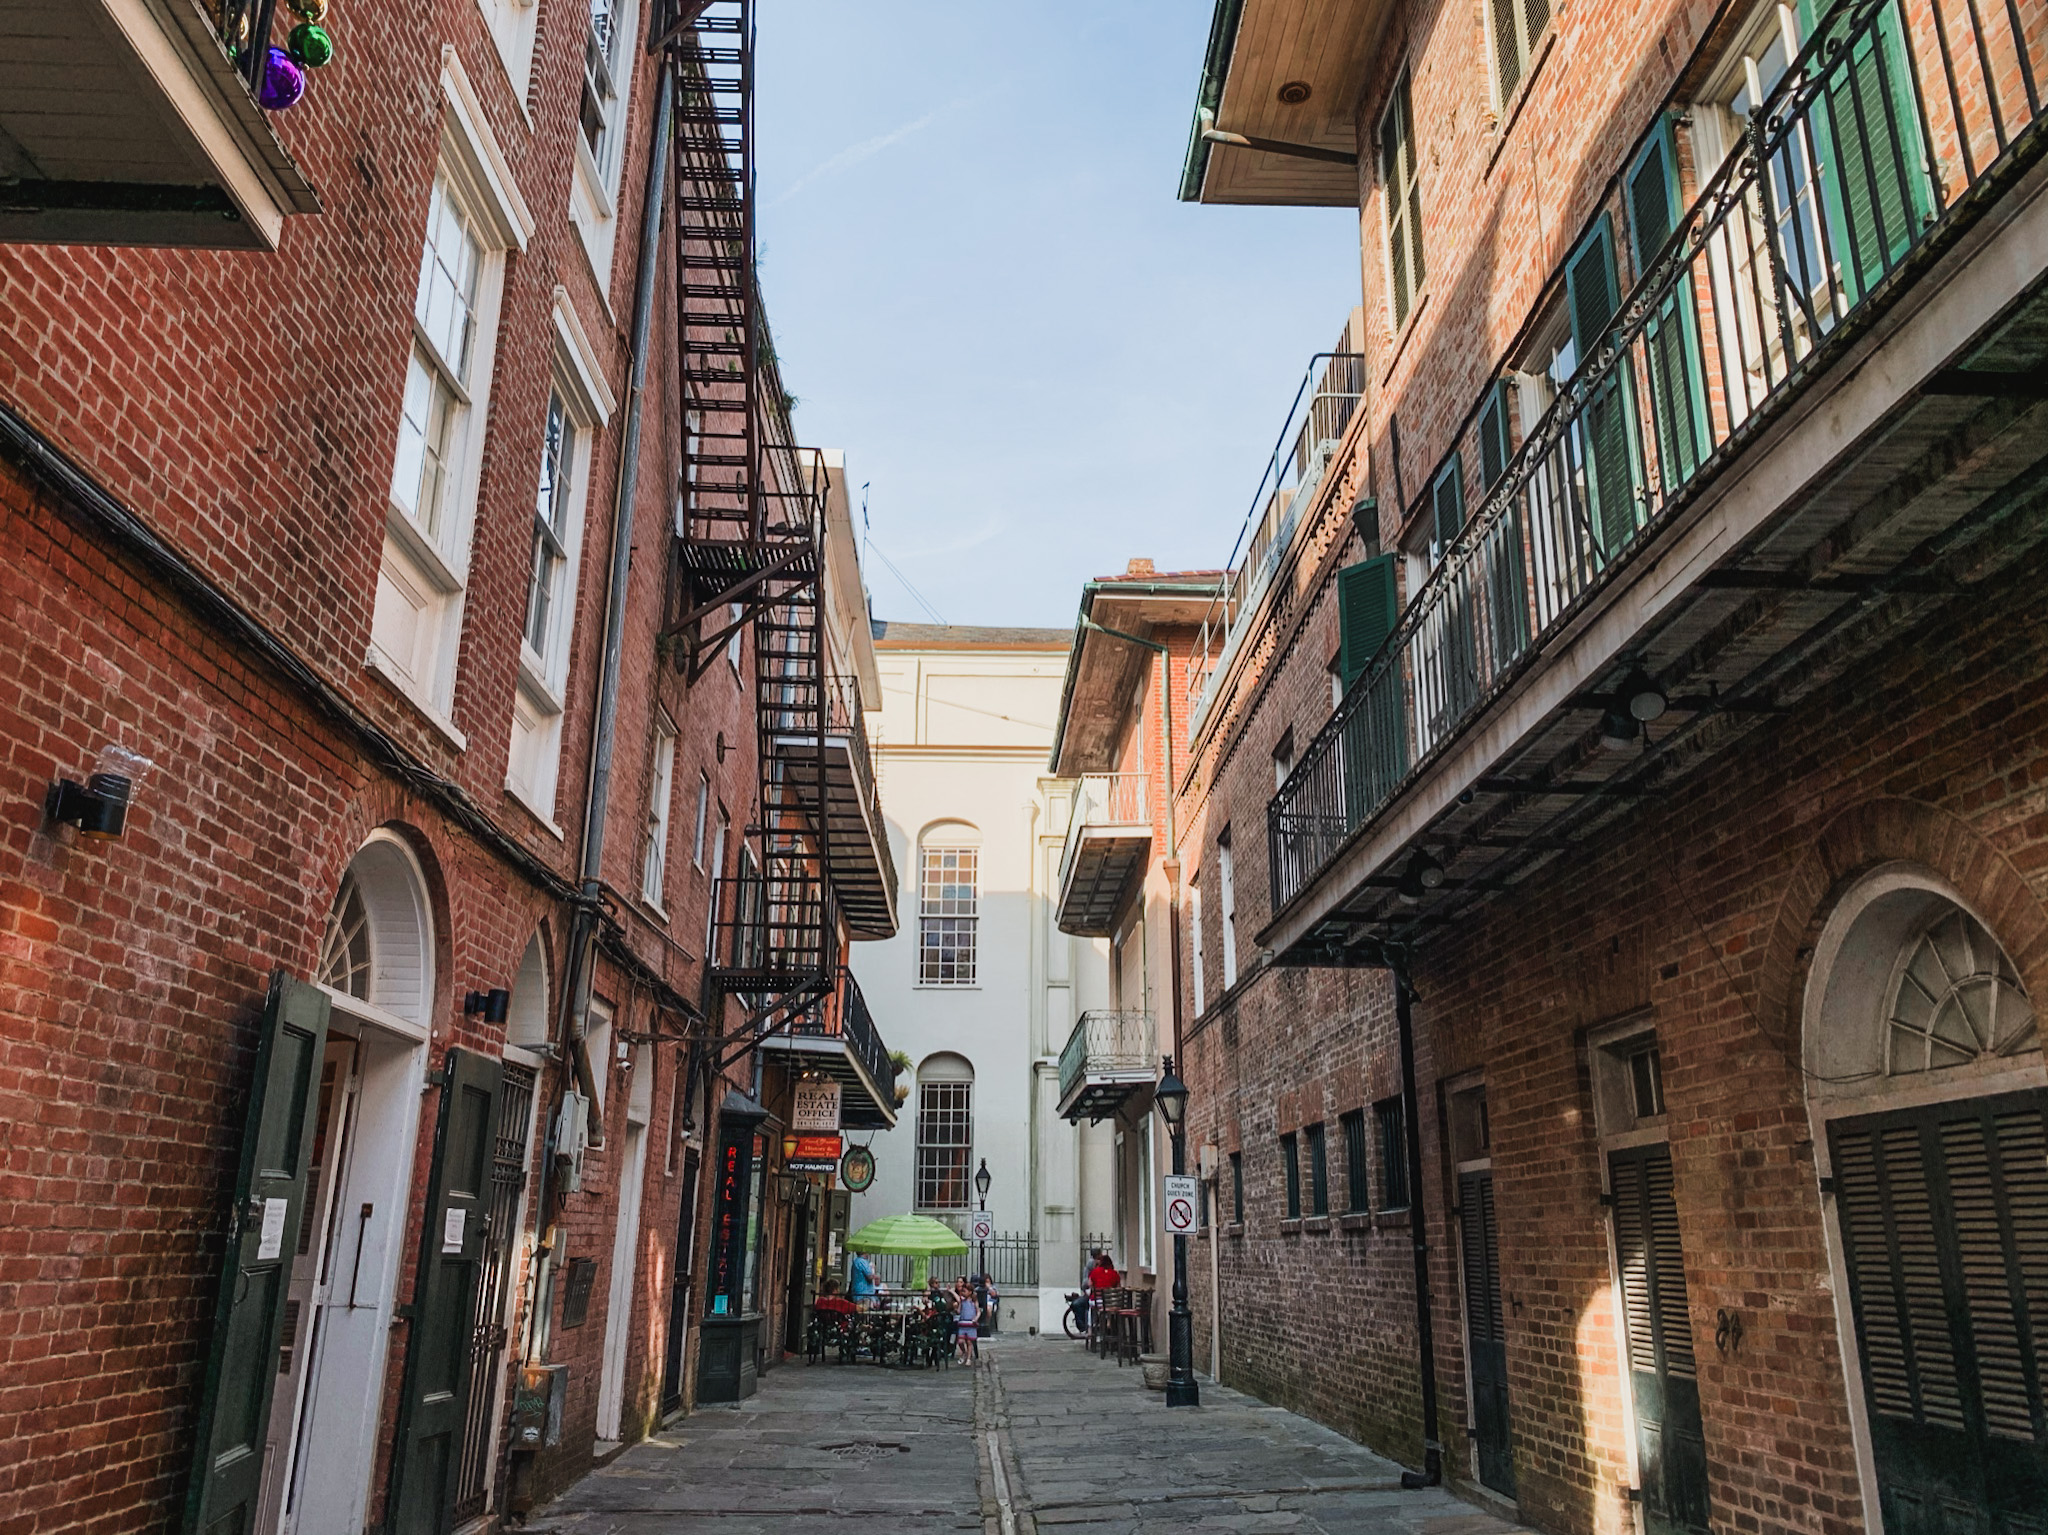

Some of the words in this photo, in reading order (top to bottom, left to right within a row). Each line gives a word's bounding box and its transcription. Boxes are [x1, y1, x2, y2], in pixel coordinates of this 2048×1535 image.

[798, 1092, 838, 1100] REAL
[797, 1101, 838, 1109] ESTATE
[798, 1109, 835, 1117] OFFICE
[726, 1146, 737, 1200] REAL
[1181, 1190, 1194, 1198] ZONE
